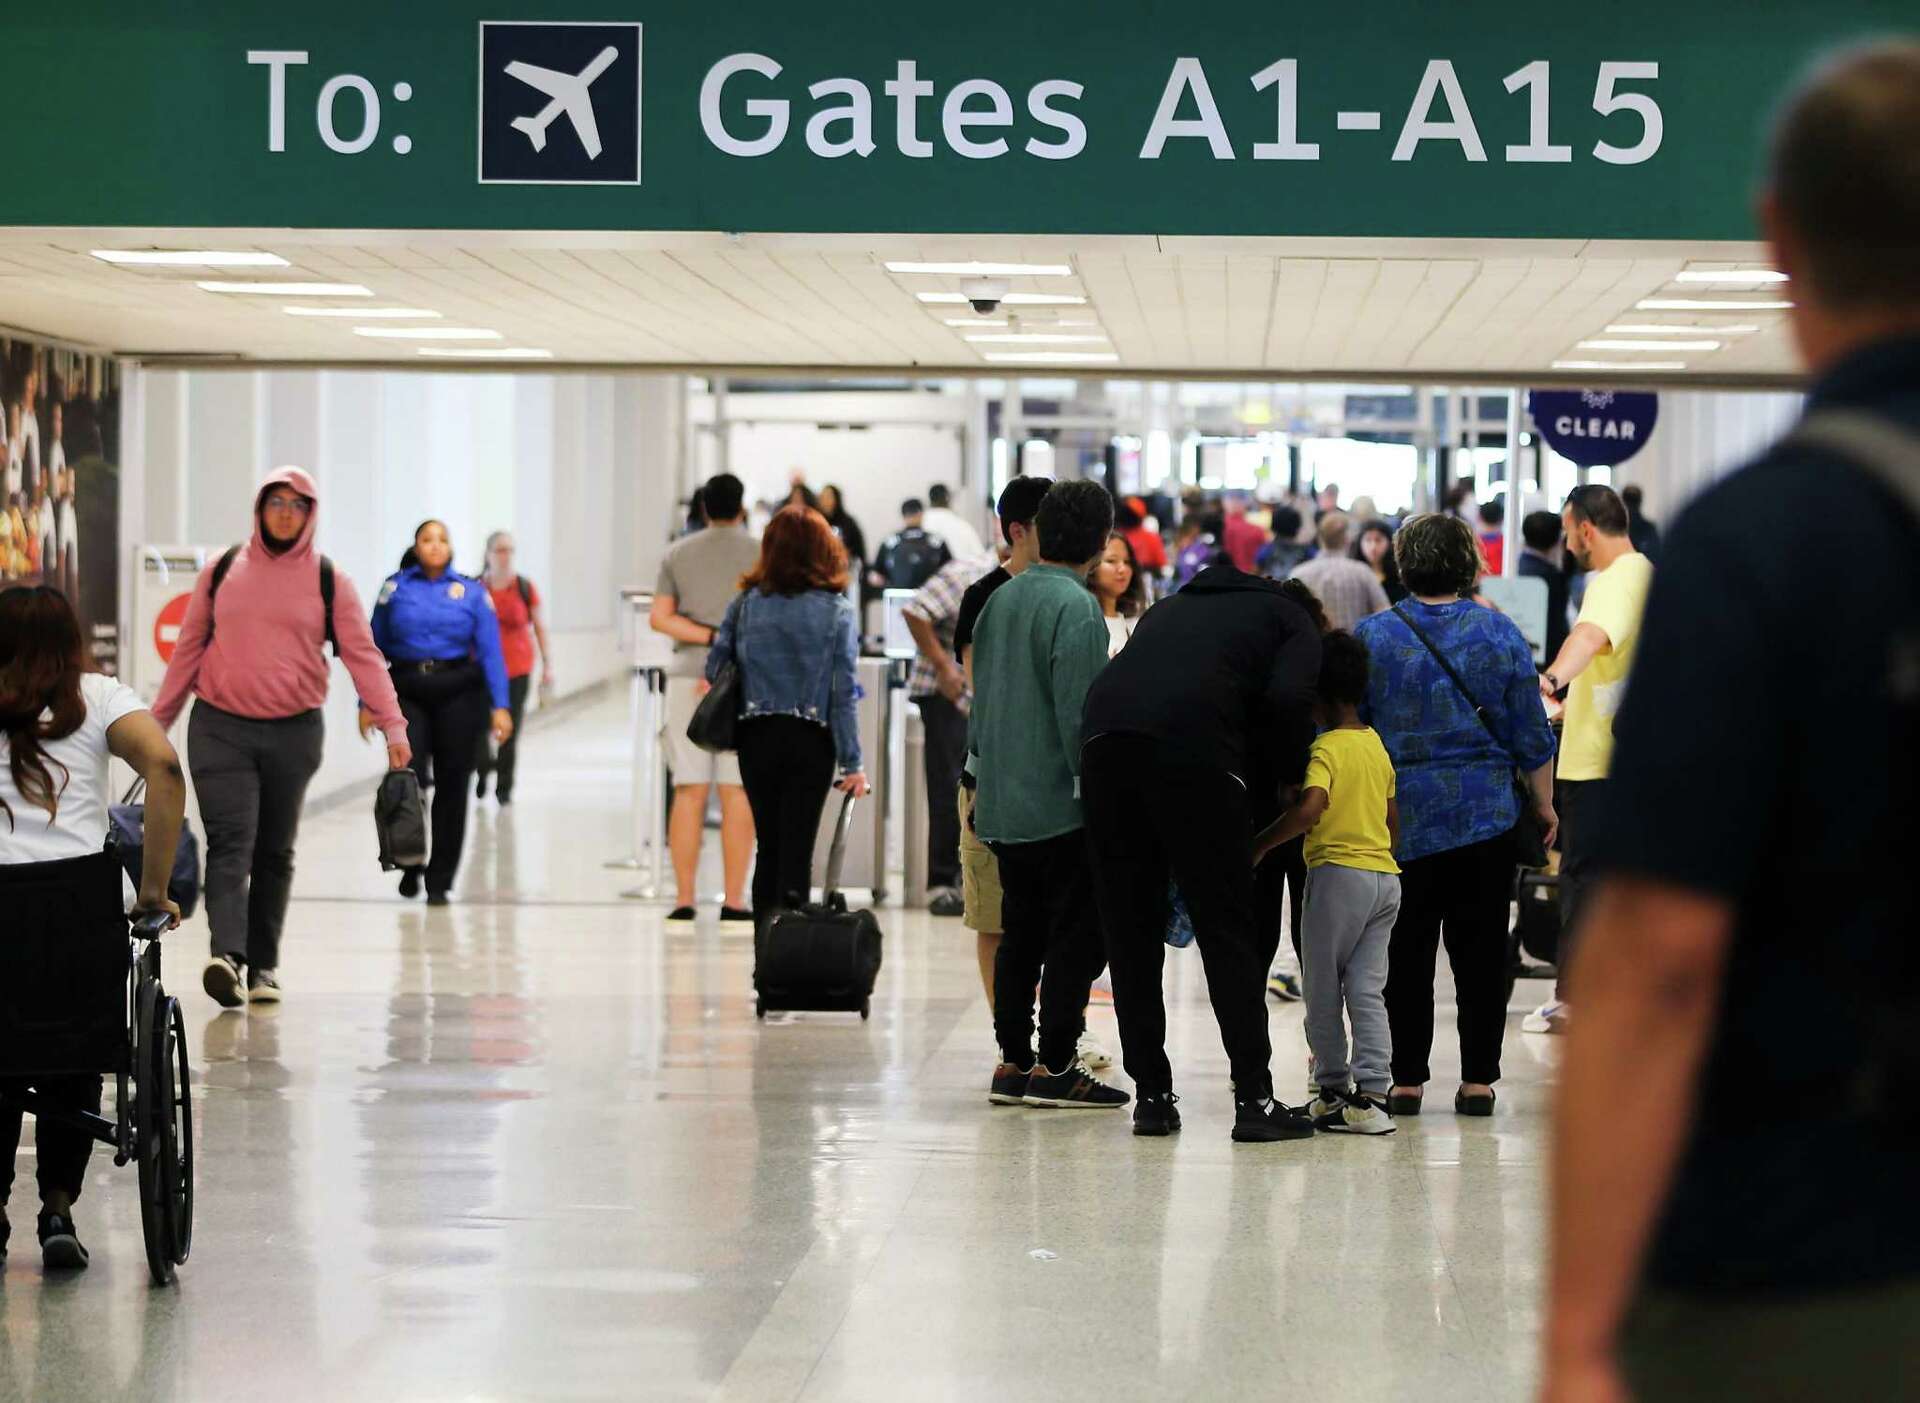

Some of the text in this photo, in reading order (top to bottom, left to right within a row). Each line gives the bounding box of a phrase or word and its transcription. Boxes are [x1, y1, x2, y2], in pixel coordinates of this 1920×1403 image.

[246, 50, 1665, 165] To: Gates A1-A15
[1555, 415, 1636, 441] CLEAR
